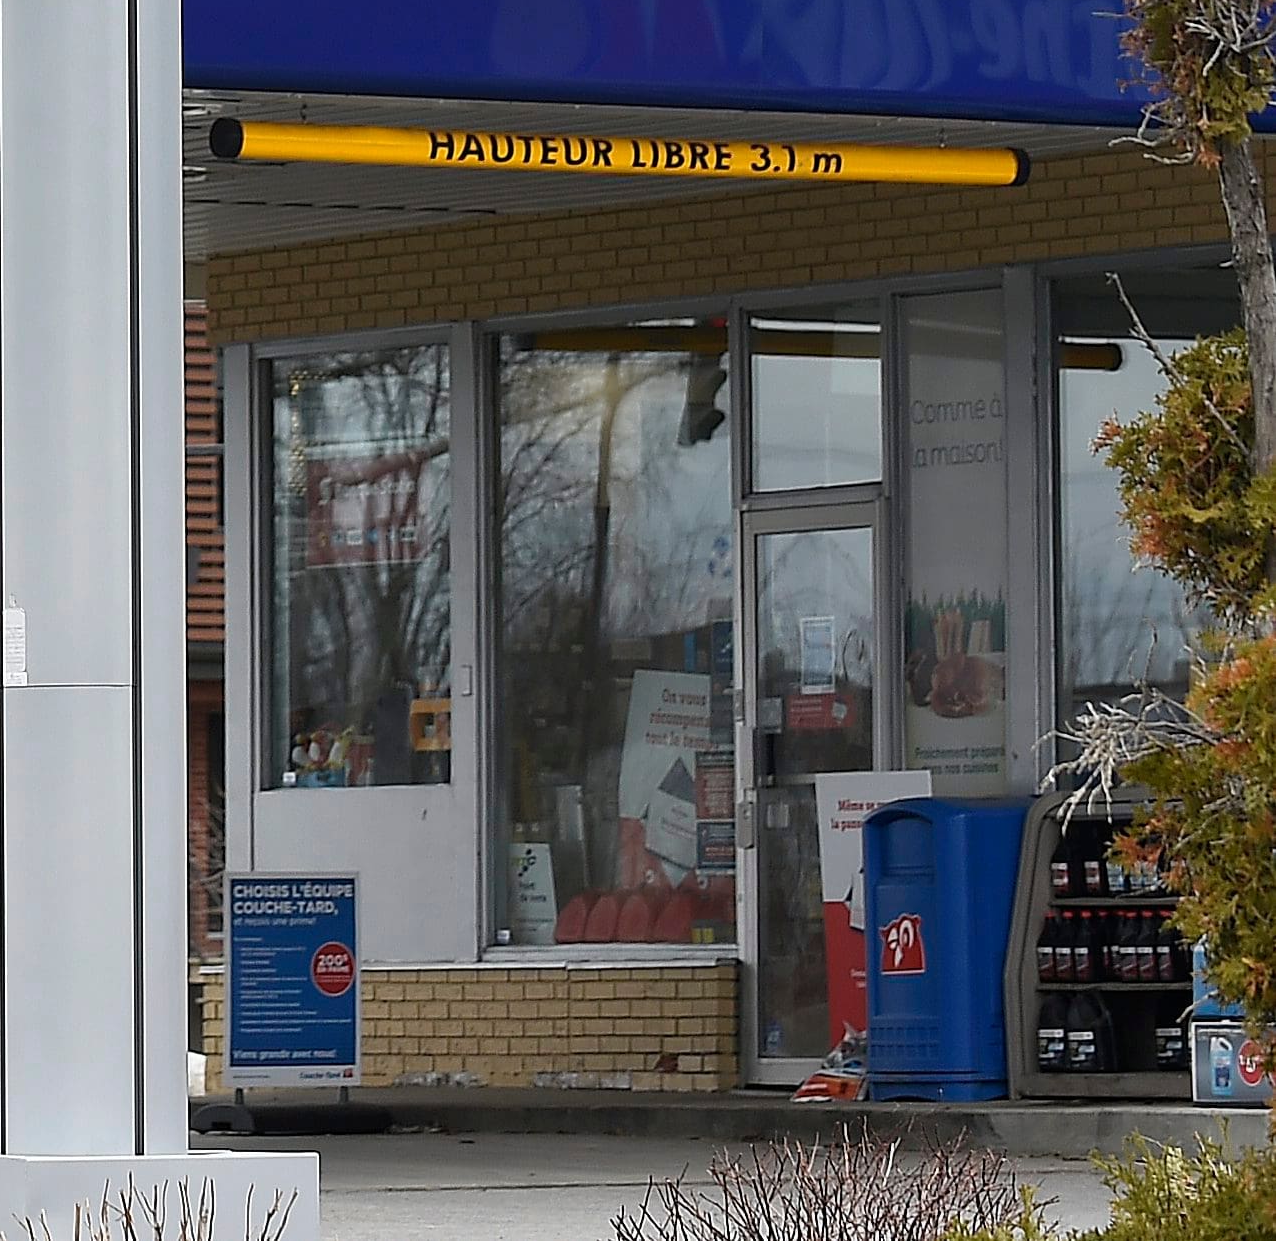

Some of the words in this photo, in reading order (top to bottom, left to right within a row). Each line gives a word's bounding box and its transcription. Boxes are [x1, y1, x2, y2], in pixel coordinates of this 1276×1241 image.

[427, 131, 614, 168] HAUTEUR
[630, 138, 732, 172] LIBRE
[749, 143, 797, 173] 3.1
[811, 150, 843, 175] m
[232, 885, 289, 898] CHOISIS
[292, 880, 354, 898] L'ÉQUIPE
[232, 900, 339, 916] COUCHE-TARD,
